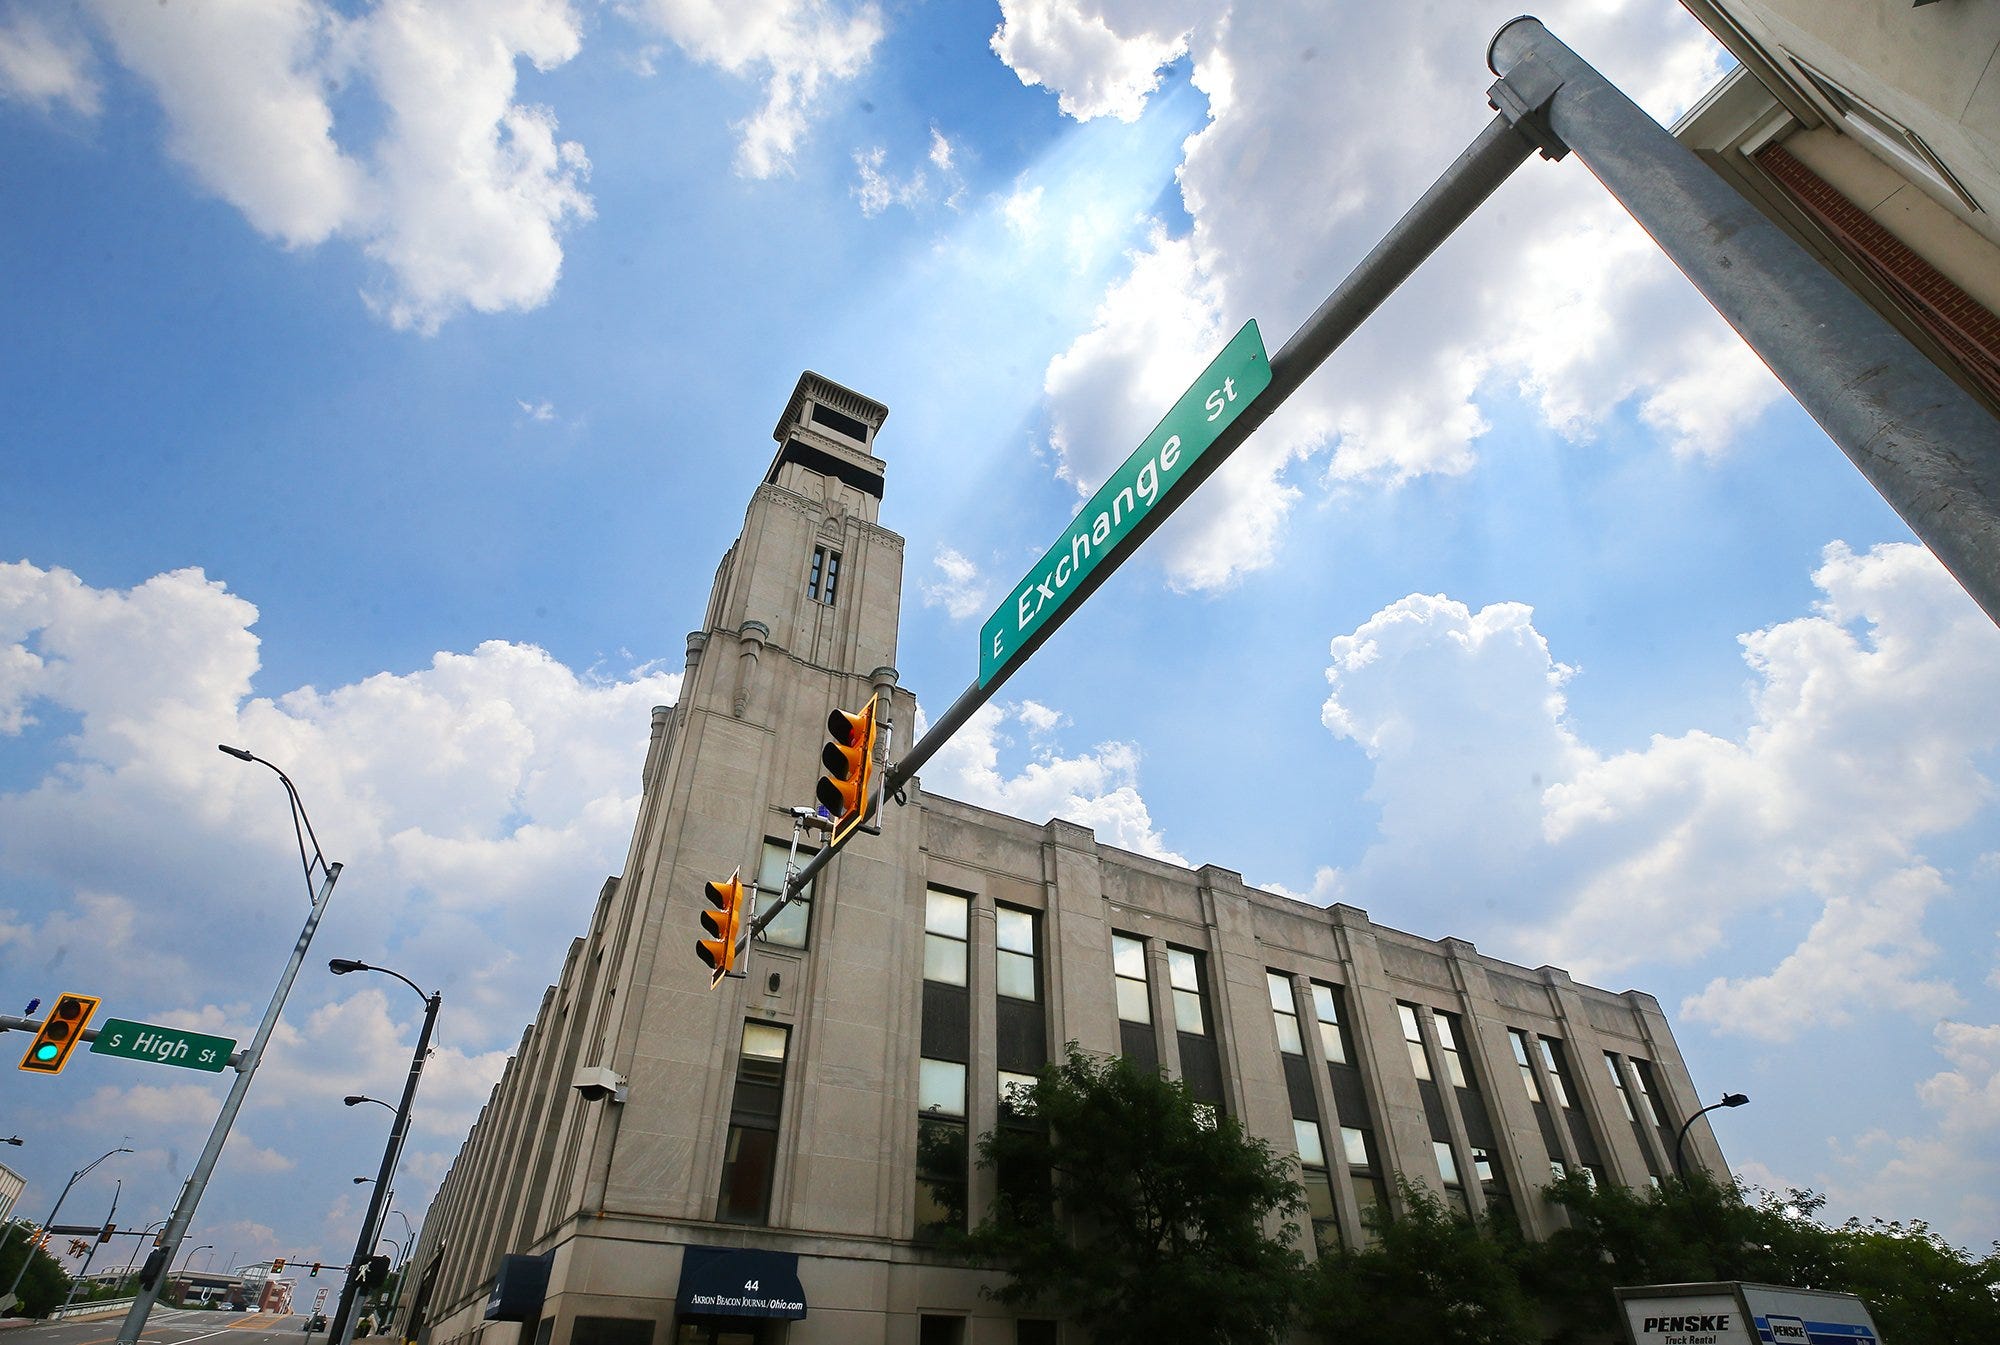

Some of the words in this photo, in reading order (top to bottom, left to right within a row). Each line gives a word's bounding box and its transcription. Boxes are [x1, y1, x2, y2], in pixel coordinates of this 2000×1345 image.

[993, 628, 1004, 660] E
[1017, 433, 1182, 632] Exchange
[1204, 375, 1238, 422] St
[109, 1033, 123, 1048] S
[132, 1032, 189, 1062] High
[198, 1048, 217, 1064] St
[744, 1280, 760, 1292] 44
[691, 1294, 716, 1305] AKRON
[716, 1295, 742, 1307] BEACON
[1643, 1314, 1730, 1333] PENSKE
[1772, 1325, 1805, 1338] PENSKE
[1664, 1335, 1688, 1345] Truck
[1689, 1334, 1717, 1345] Rental
